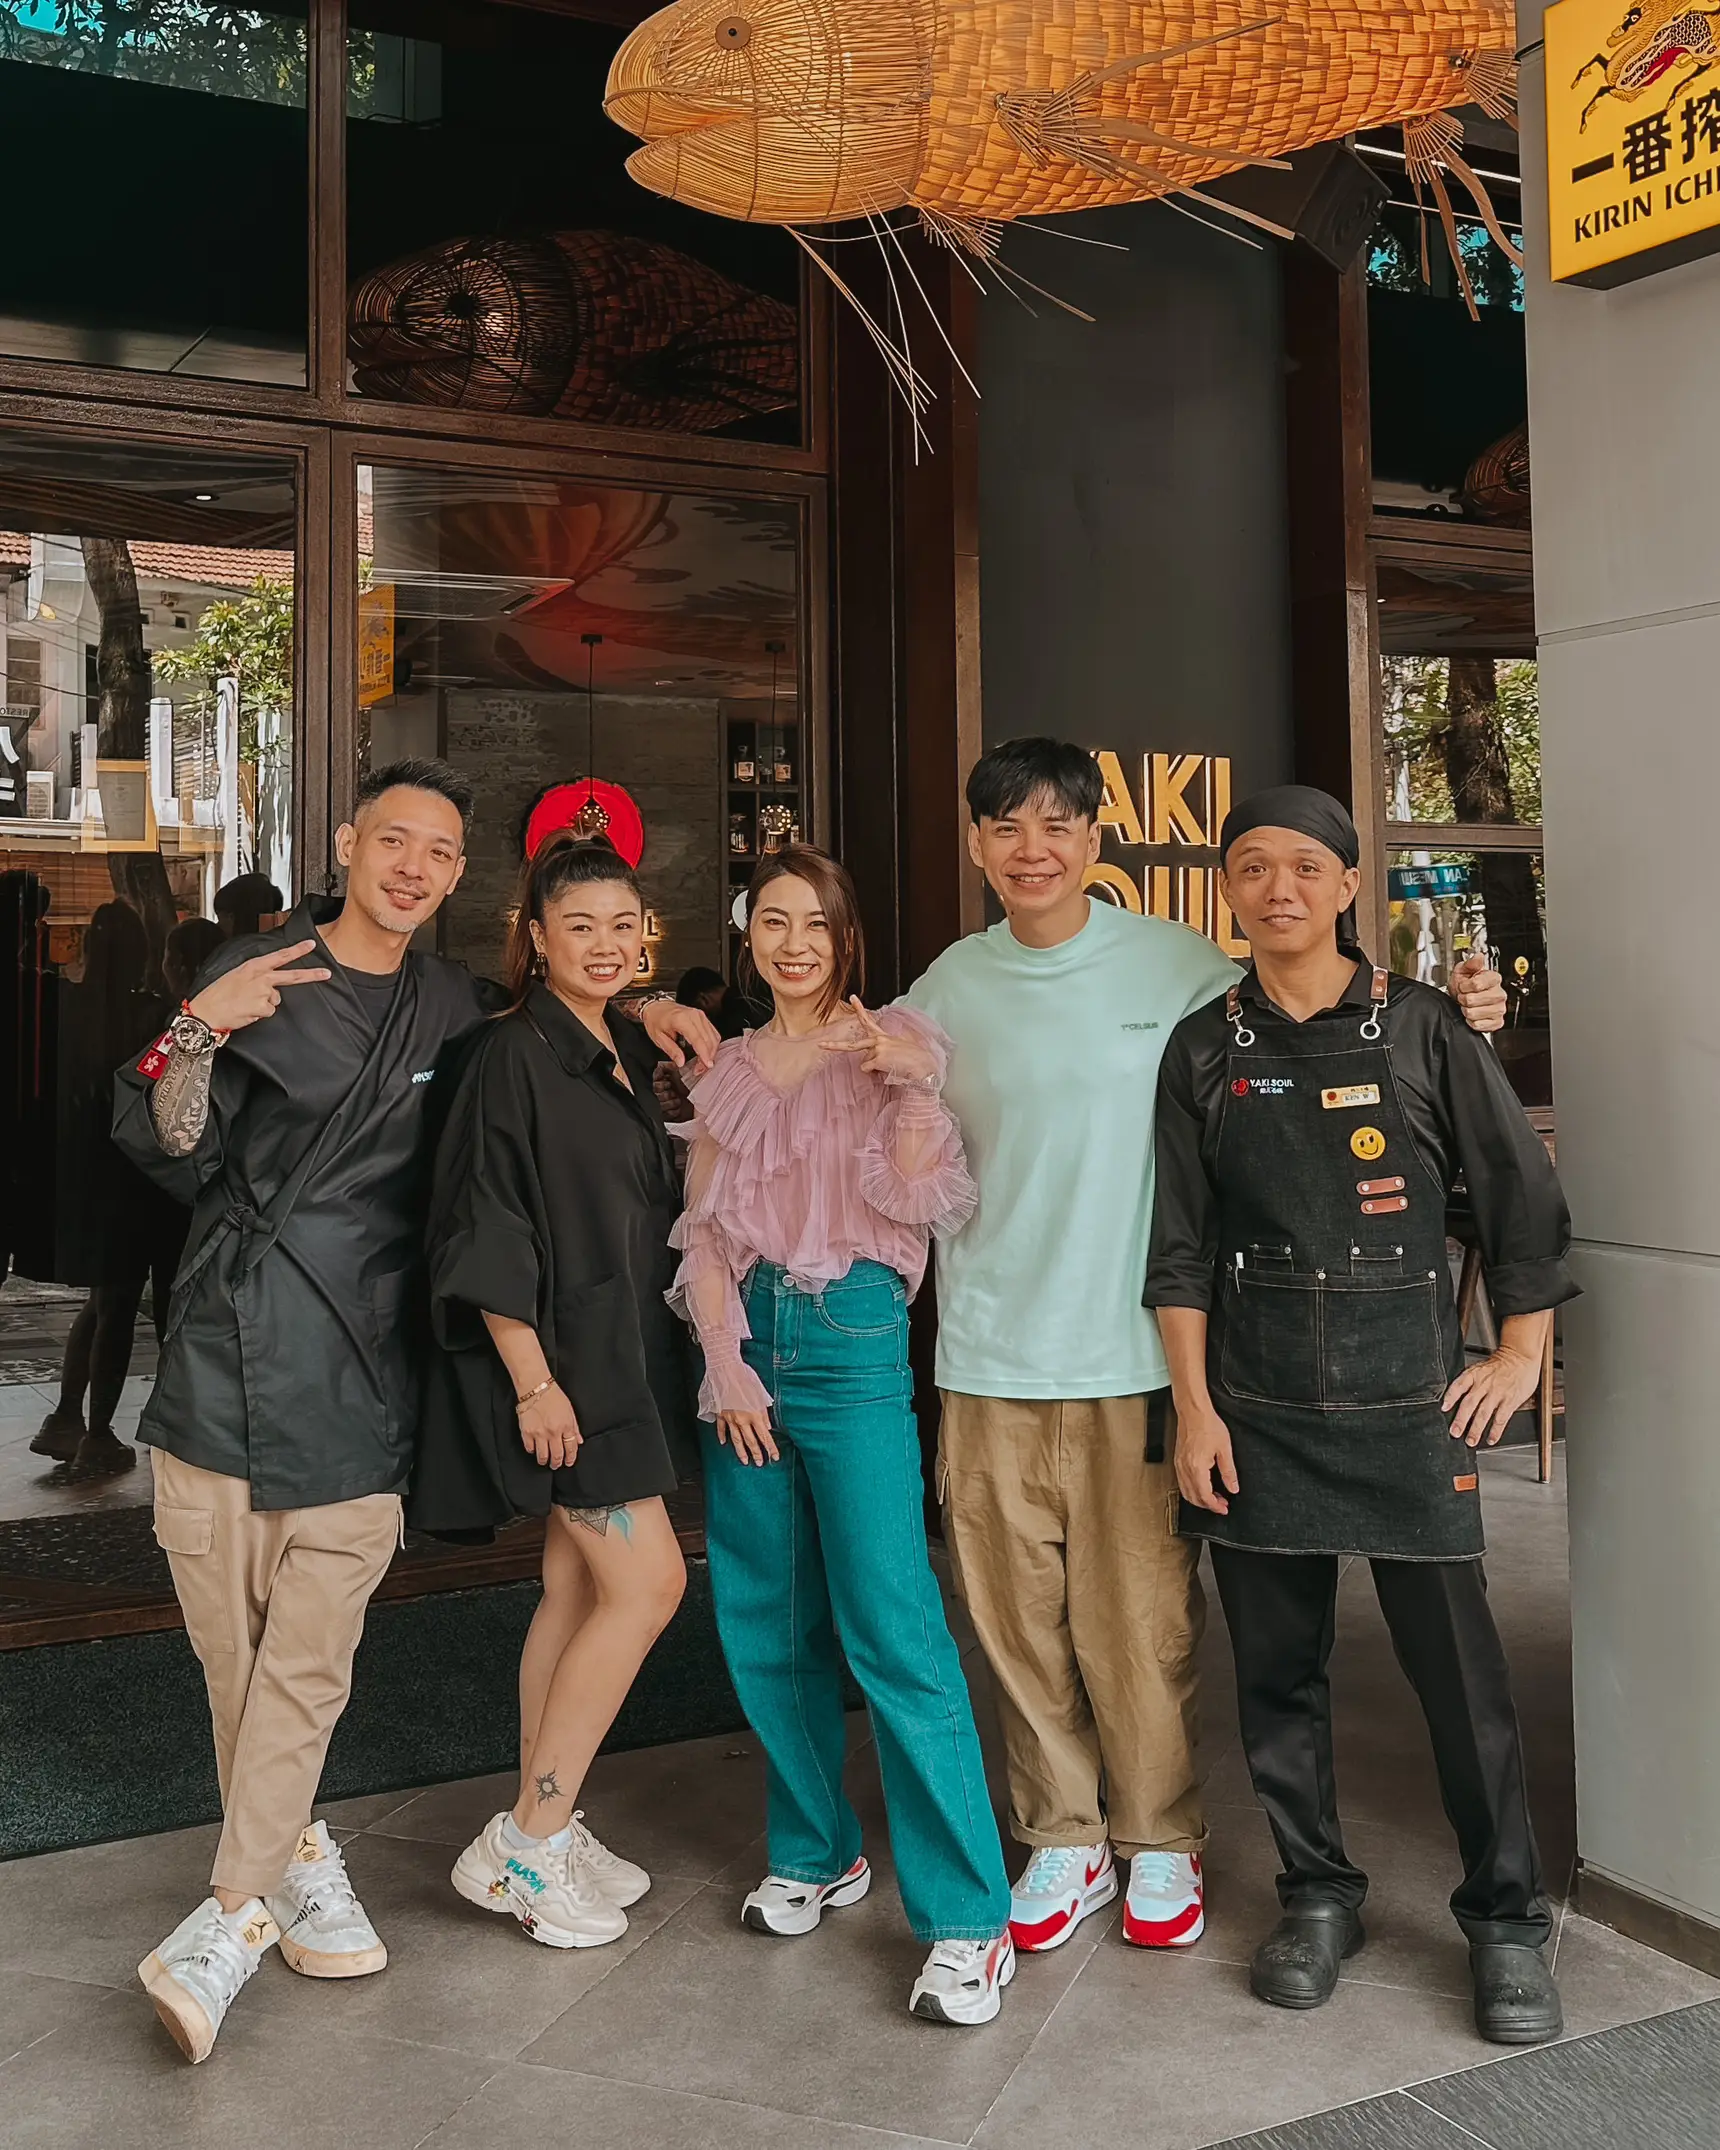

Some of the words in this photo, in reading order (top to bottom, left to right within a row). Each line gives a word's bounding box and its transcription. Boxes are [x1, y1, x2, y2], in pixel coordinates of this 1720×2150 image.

[1574, 190, 1652, 243] KIRIN
[1090, 750, 1232, 847] AKI
[1249, 1078, 1270, 1088] YAKI
[1270, 1078, 1295, 1088] SOUL
